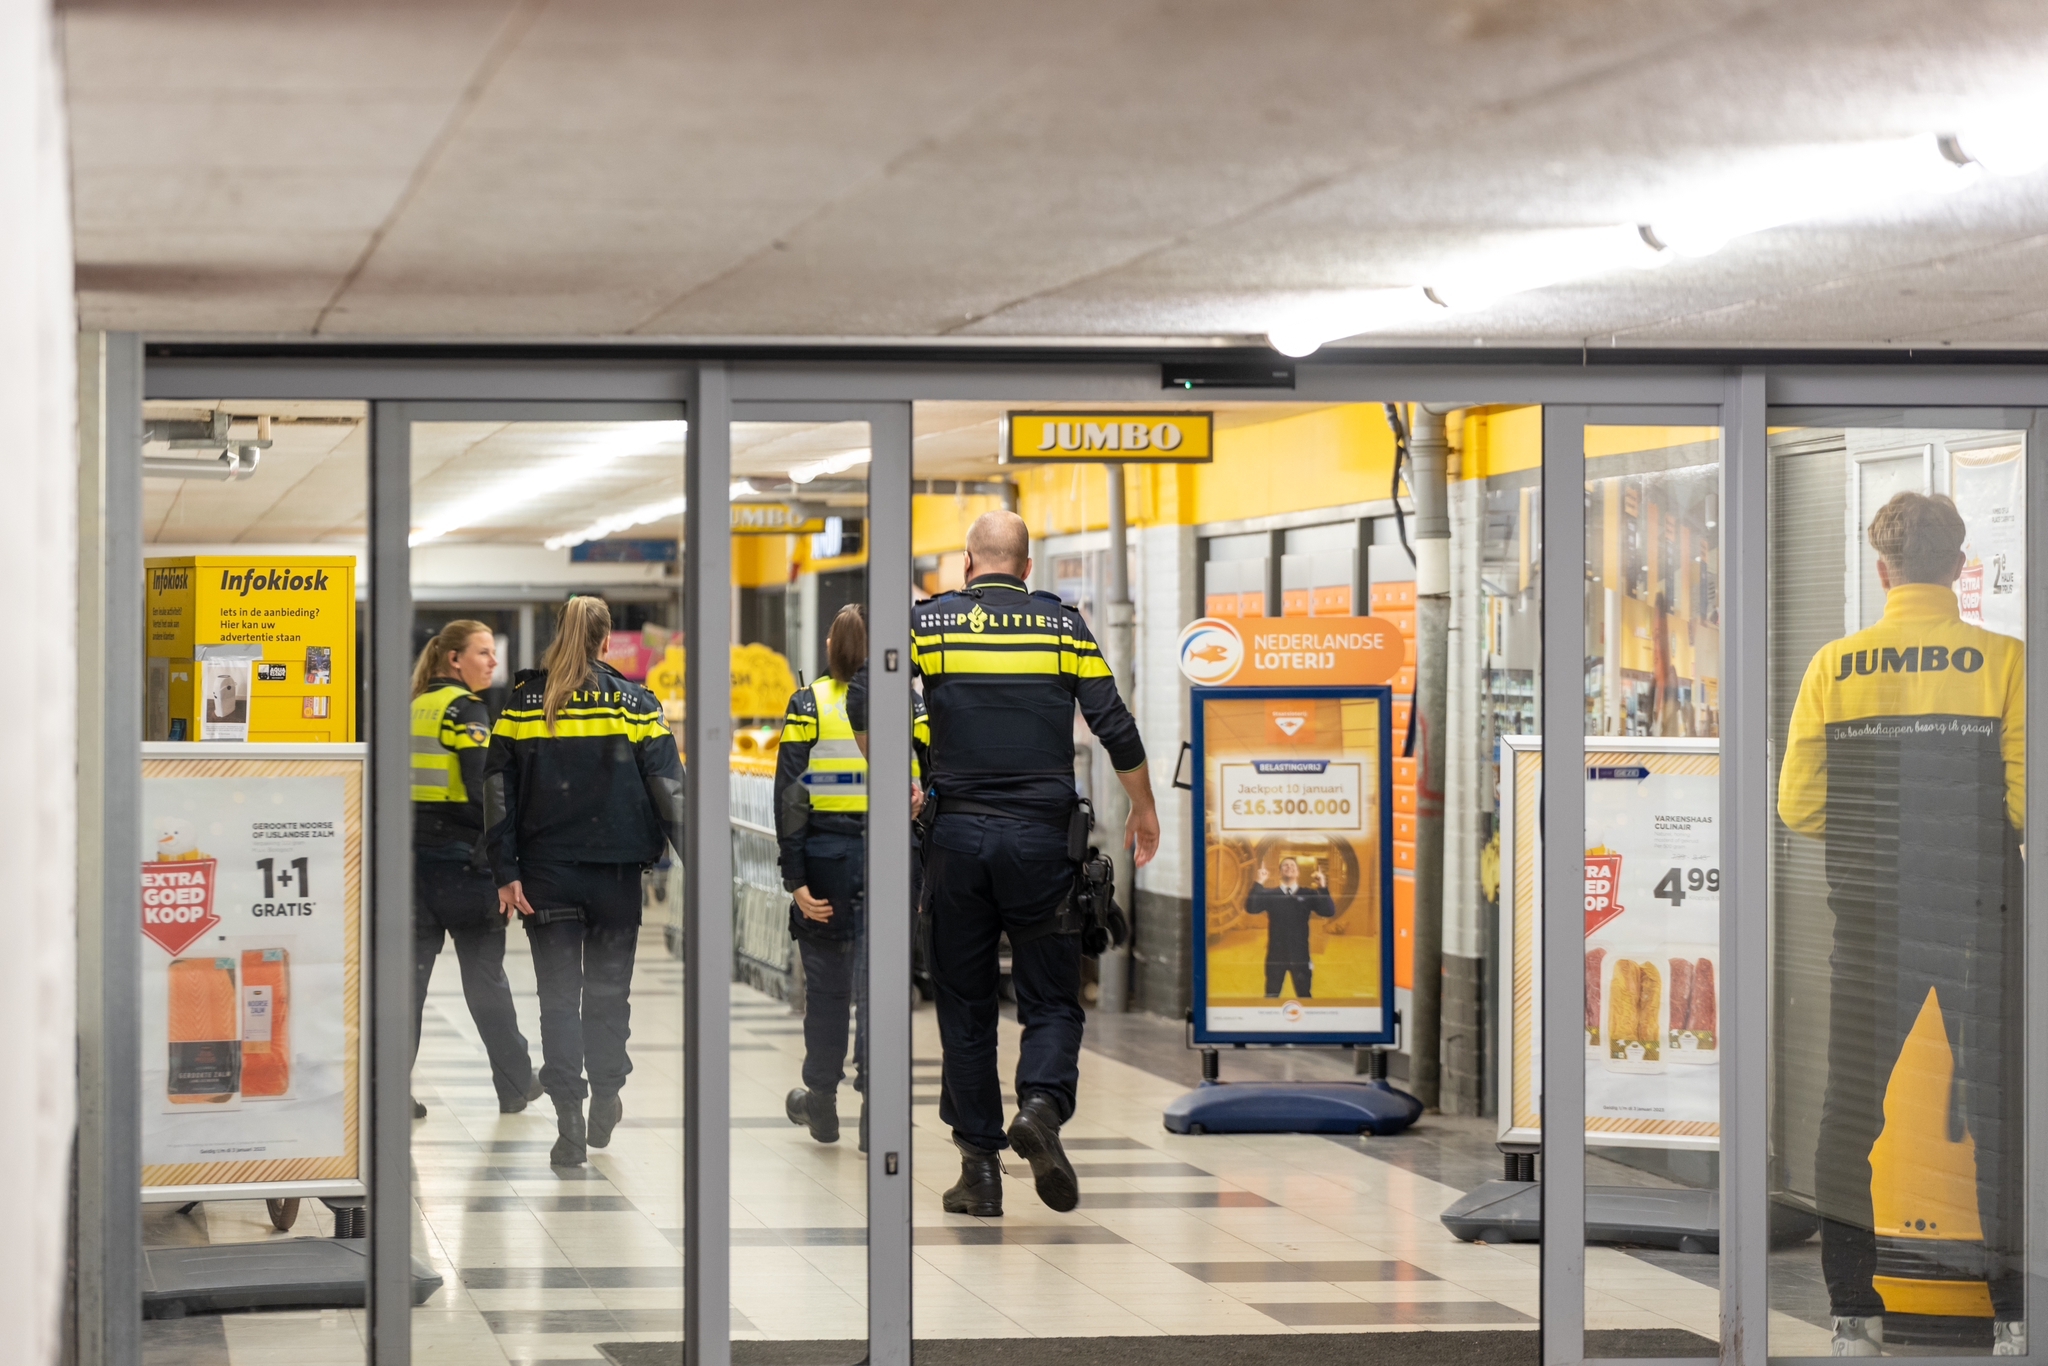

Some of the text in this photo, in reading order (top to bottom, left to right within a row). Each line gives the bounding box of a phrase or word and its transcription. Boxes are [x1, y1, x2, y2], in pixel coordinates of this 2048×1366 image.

[1036, 421, 1183, 451] JUMBO
[730, 506, 804, 528] UMBO
[152, 567, 189, 597] Infokiosk
[220, 568, 329, 597] Infokiosk
[220, 607, 320, 620] Iets in de aanbieding?
[957, 606, 1046, 632] POLITIE
[220, 620, 276, 629] Hier kan uw
[220, 632, 301, 642] advertentie staan
[1253, 633, 1384, 651] NEDERLANDSE
[1253, 652, 1336, 670] LOTERIJ
[1835, 645, 1984, 681] JUMBO
[1833, 719, 1994, 741] Je boodschappen bezorg ik graag!
[1259, 763, 1322, 772] BELASTINGVRIJ
[1237, 784, 1344, 795] Jackpot 10 januari
[1231, 798, 1351, 816] €16.300.000
[252, 822, 298, 830] GEROOKTE
[1654, 815, 1713, 824] VARKENSHAAS
[1654, 823, 1692, 831] CULINAIR
[312, 830, 334, 838] ZALM
[141, 871, 206, 888] EXTRA
[256, 856, 309, 899] 1+1
[1585, 865, 1612, 878] RA
[143, 887, 206, 906] GOED
[144, 906, 205, 924] KOOP
